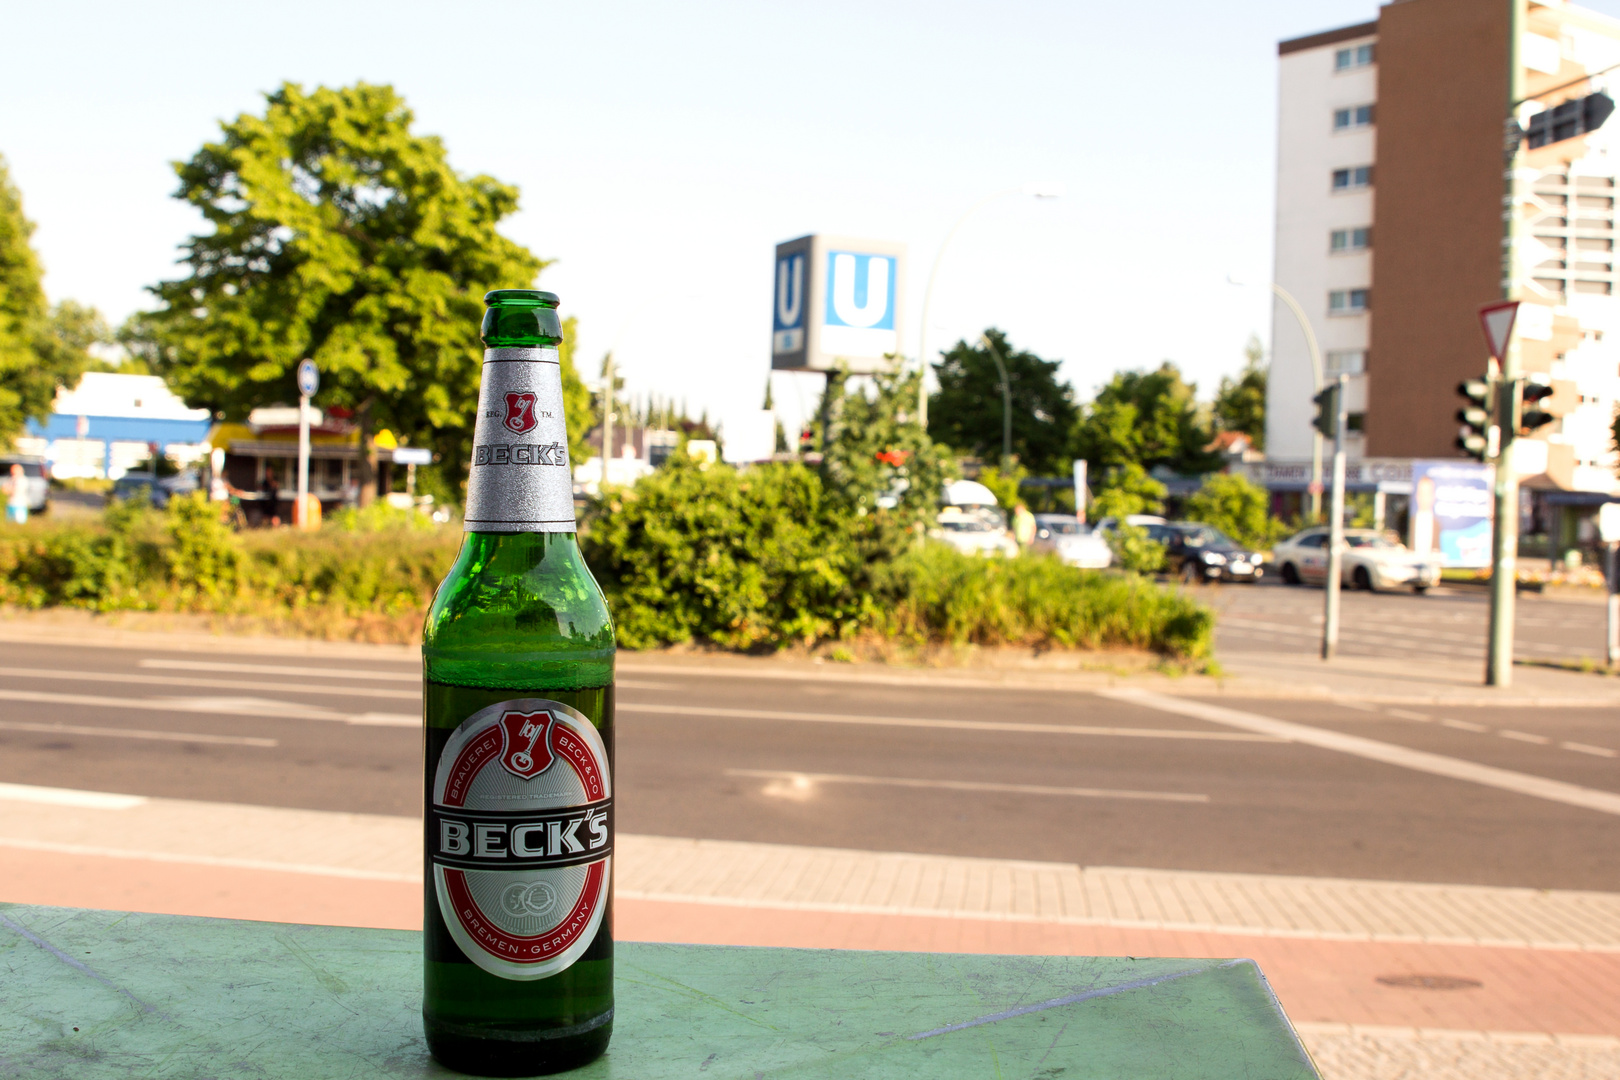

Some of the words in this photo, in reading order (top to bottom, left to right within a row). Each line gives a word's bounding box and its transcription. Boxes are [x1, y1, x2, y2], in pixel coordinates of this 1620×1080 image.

[780, 256, 802, 327] U
[833, 253, 889, 328] U
[475, 442, 566, 467] BECK'S
[451, 738, 497, 799] BRAUEREI
[440, 808, 608, 859] BECK'S
[463, 908, 519, 953] BREMEN
[531, 902, 589, 954] GERMANY
